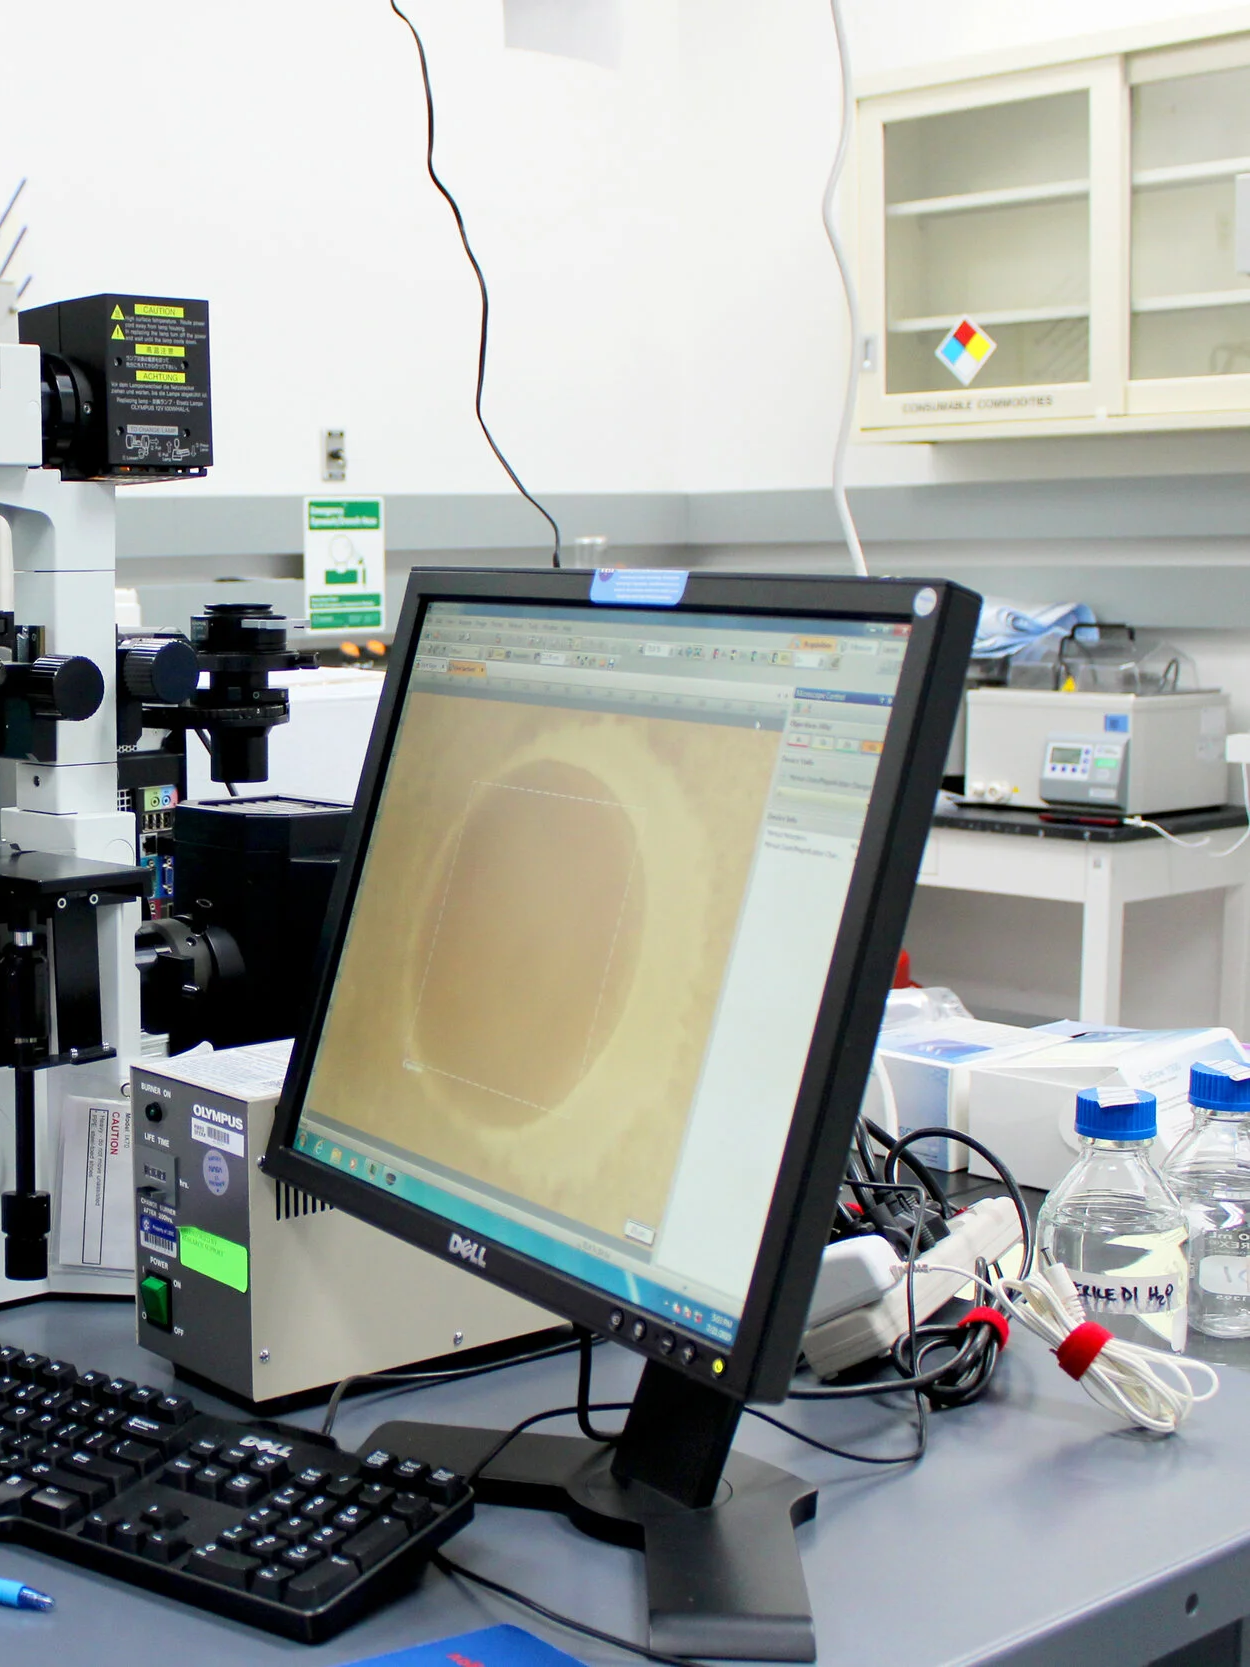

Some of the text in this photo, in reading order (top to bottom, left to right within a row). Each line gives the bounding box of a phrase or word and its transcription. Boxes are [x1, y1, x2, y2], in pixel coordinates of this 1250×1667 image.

[143, 306, 176, 316] CAUTION
[143, 372, 178, 382] ACHTUNG
[902, 394, 1053, 413] CONSUMABLE COMMODITIES
[141, 1082, 171, 1098] BURNER ON
[193, 1104, 244, 1131] OLYMPUS
[110, 1111, 120, 1155] CAUTION
[144, 1132, 170, 1148] LIFE TIME
[449, 1232, 486, 1268] DELL
[150, 1256, 168, 1271] POWER
[173, 1279, 182, 1289] ON
[1073, 1281, 1117, 1300] ERILE
[1121, 1286, 1138, 1301] DI
[174, 1326, 184, 1337] OFF
[239, 1435, 293, 1458] DELL
